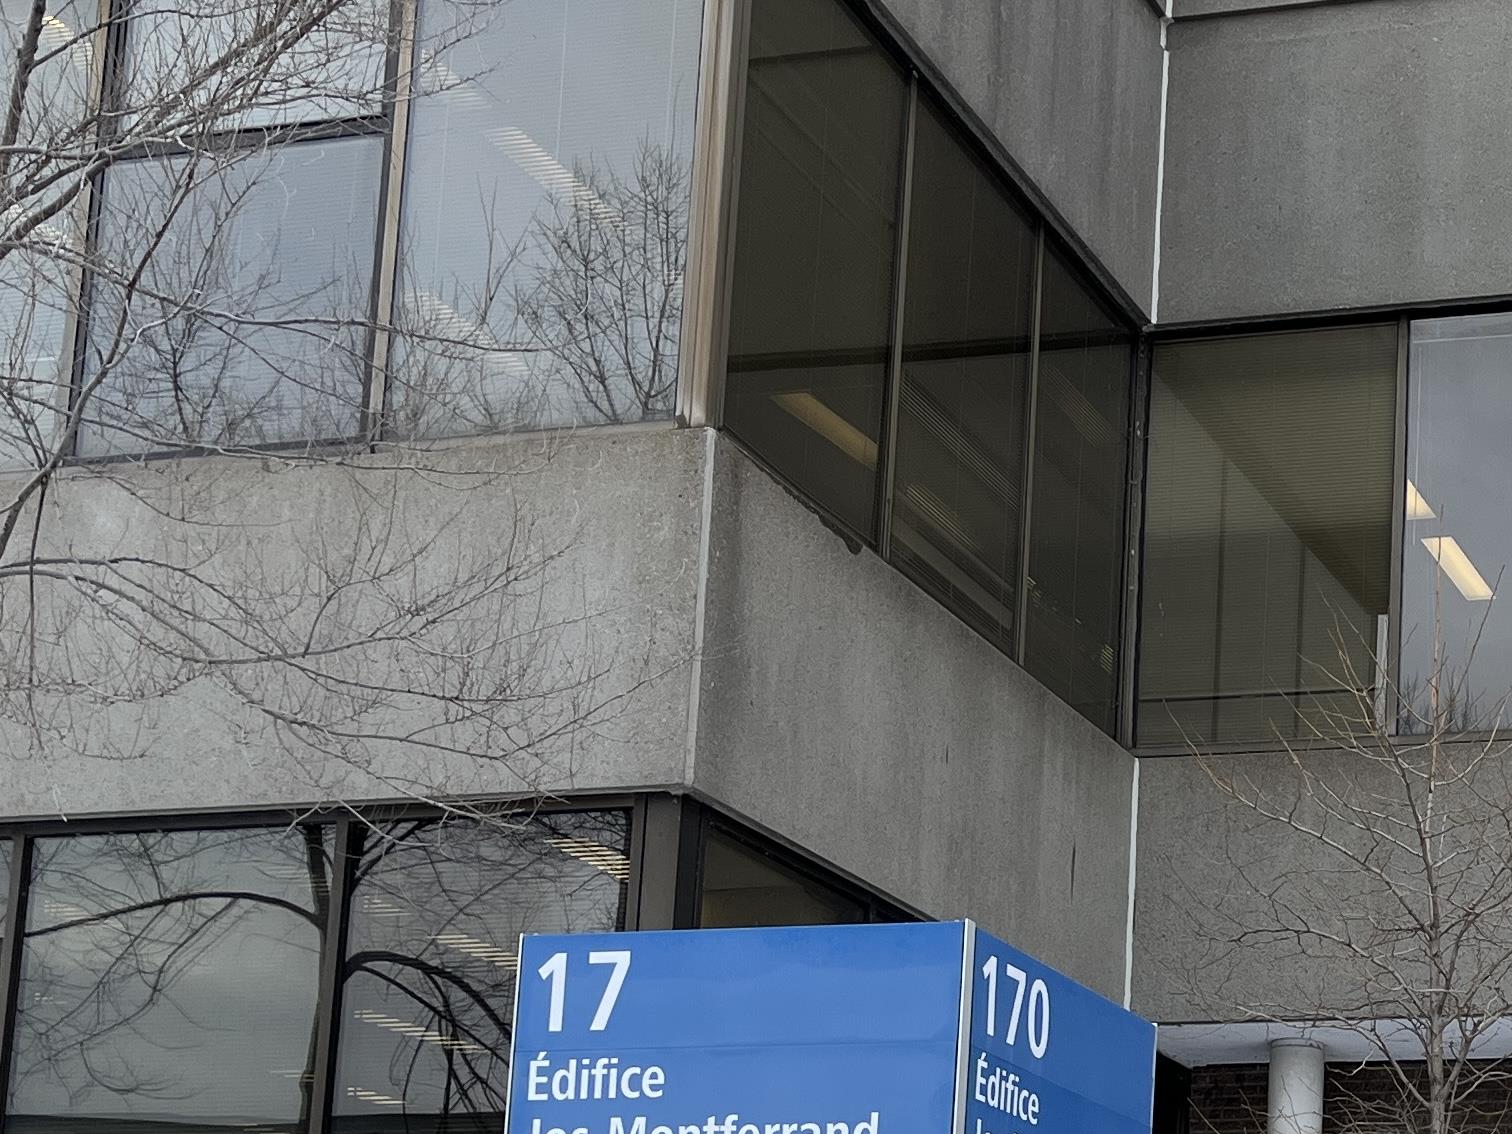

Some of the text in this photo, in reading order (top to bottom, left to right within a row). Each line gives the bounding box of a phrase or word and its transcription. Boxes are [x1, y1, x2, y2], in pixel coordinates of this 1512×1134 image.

[537, 950, 631, 1032] 17
[982, 955, 1050, 1059] 170
[527, 1051, 665, 1101] Édifice
[975, 1052, 1040, 1125] Édifice
